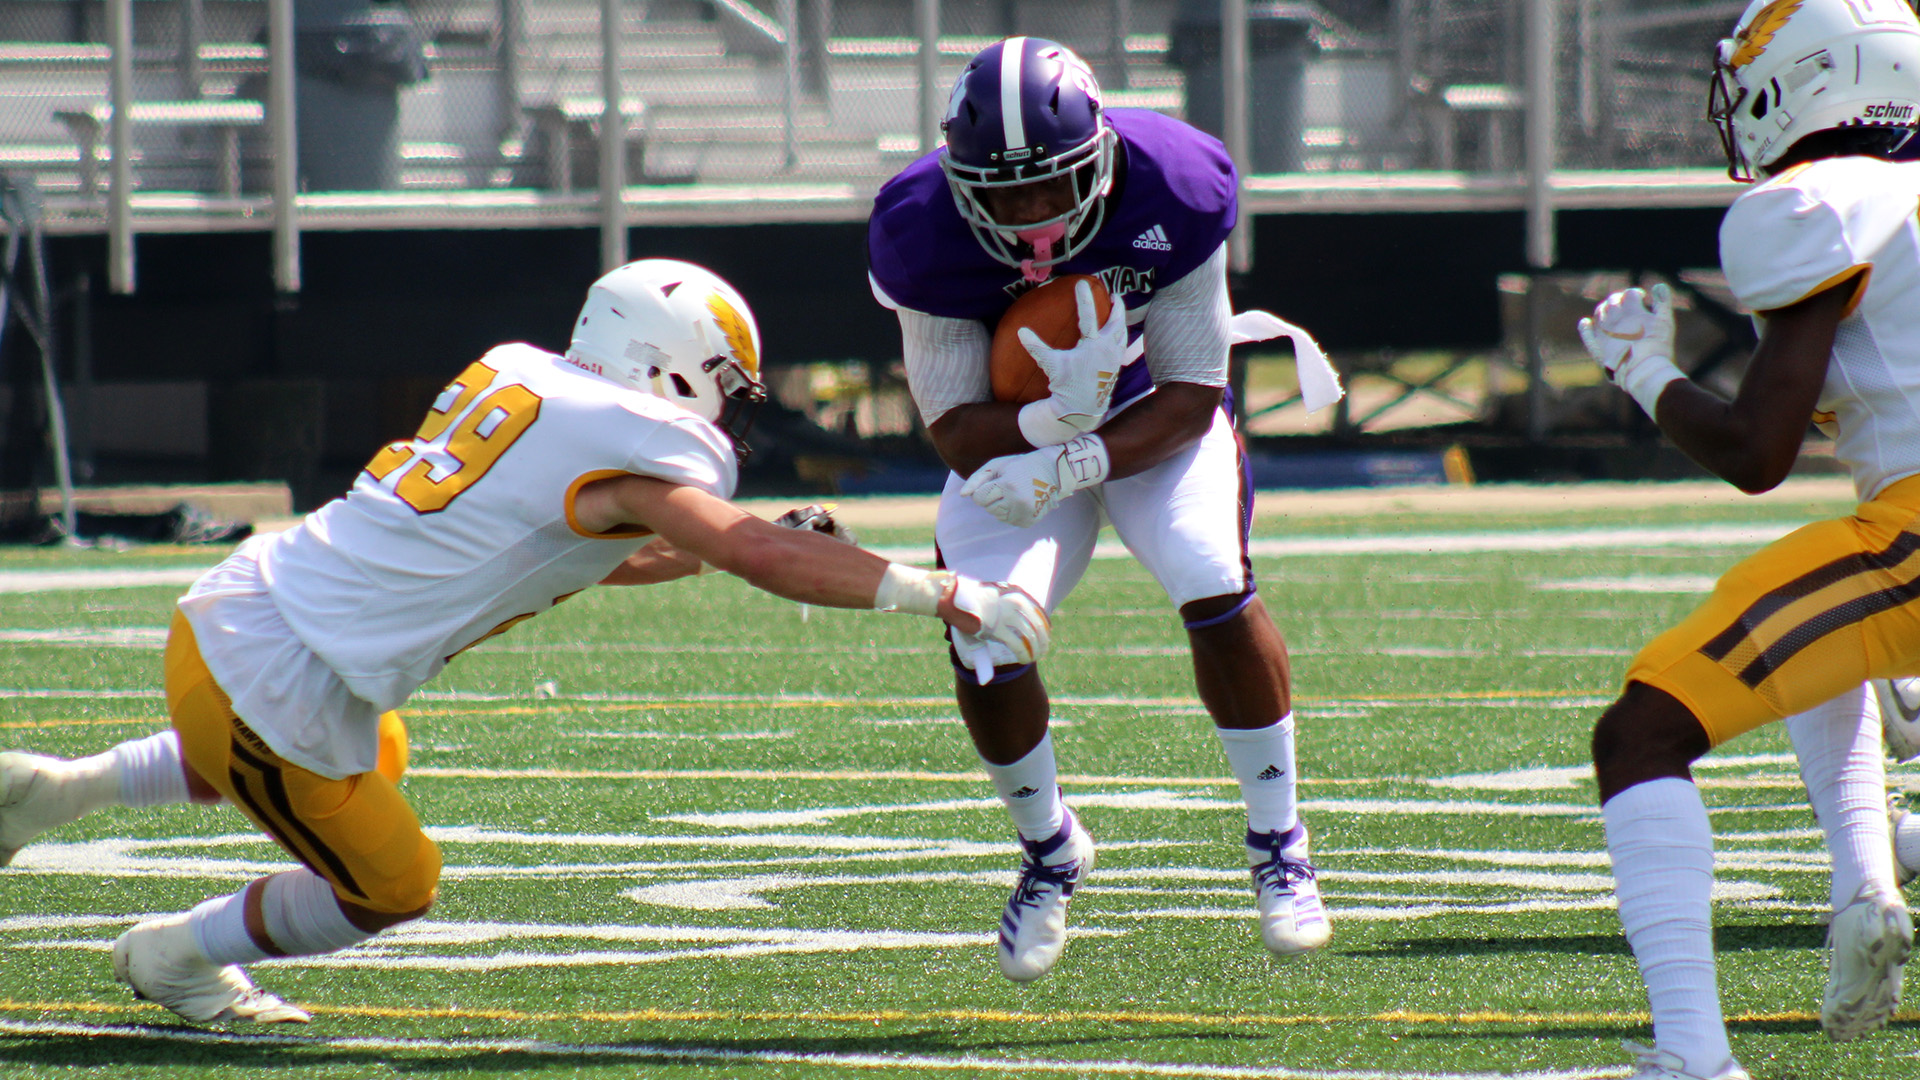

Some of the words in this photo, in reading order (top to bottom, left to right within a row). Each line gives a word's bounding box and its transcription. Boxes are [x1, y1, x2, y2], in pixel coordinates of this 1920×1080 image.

[1864, 101, 1914, 118] schutt
[1132, 239, 1172, 251] adidas
[364, 361, 543, 515] 29
